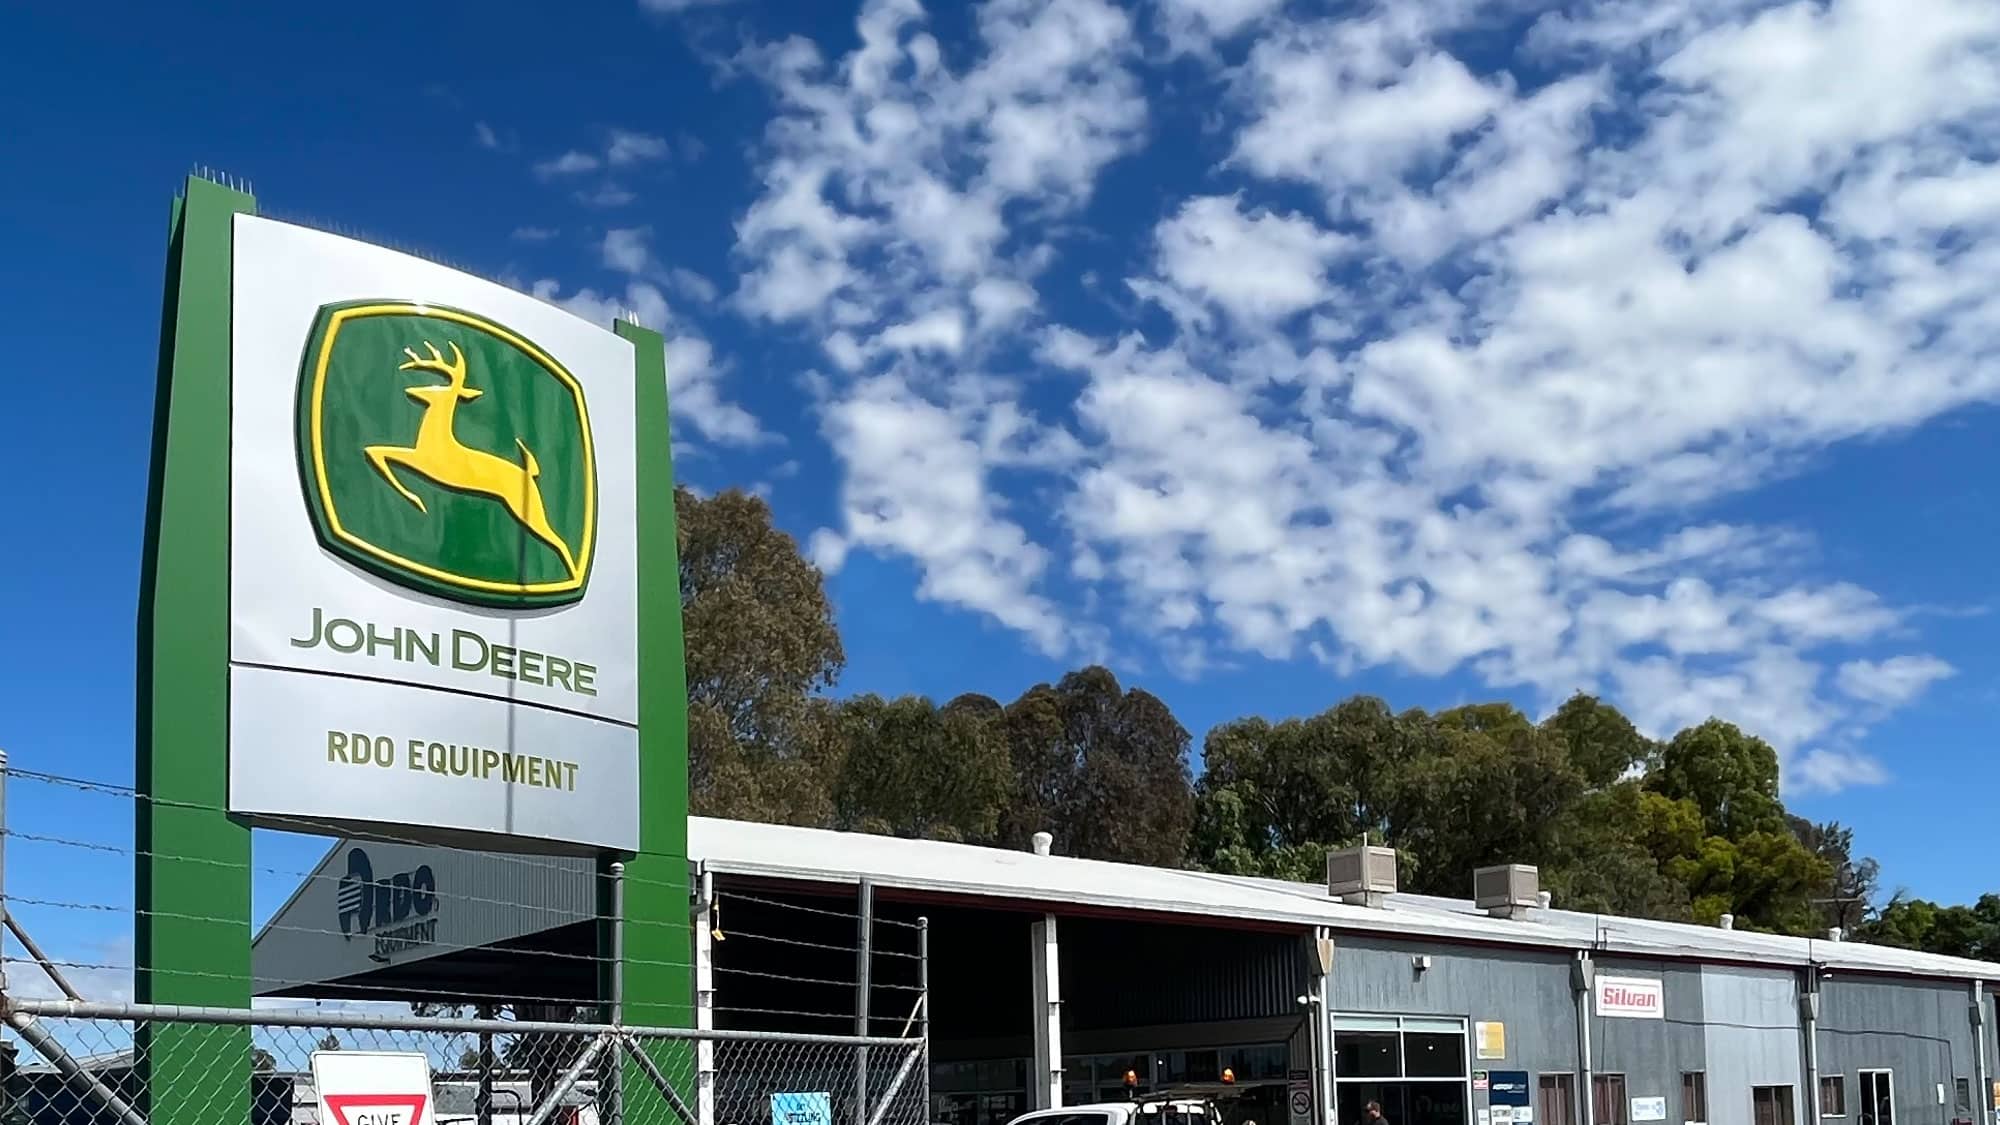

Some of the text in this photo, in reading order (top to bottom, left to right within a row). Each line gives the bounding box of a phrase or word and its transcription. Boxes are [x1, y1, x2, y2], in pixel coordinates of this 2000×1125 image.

[290, 607, 597, 696] JOHN DEERE
[327, 730, 579, 792] RDO EQUIPMENT
[357, 1113, 401, 1125] GIVE
